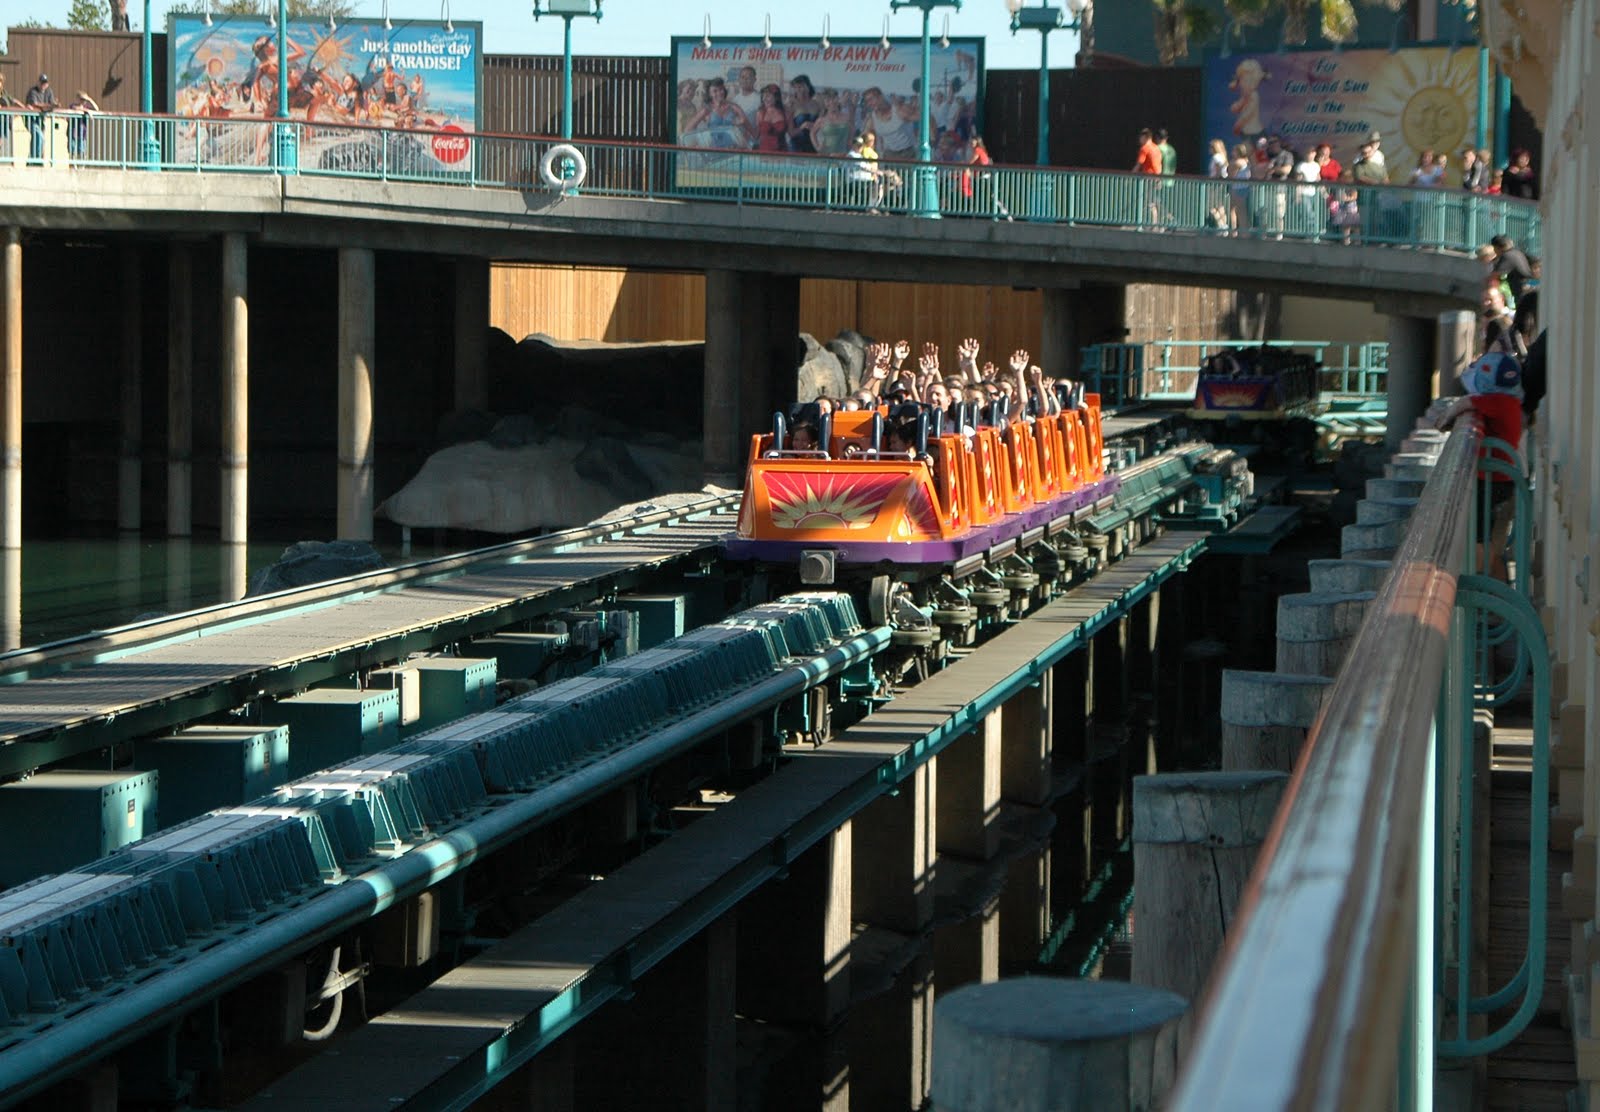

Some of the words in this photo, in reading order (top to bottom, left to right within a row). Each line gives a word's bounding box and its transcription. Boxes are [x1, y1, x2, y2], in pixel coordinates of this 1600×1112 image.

[360, 38, 390, 53] Just
[393, 40, 445, 55] another
[447, 40, 471, 59] day
[823, 46, 895, 61] BRAWNY
[374, 54, 387, 68] in
[391, 53, 461, 70] PARADISE!
[1316, 58, 1338, 73] For
[1284, 80, 1309, 94] Fun
[1312, 79, 1339, 94] and
[1343, 79, 1370, 93] Sun
[1306, 102, 1319, 113] in
[1280, 120, 1329, 134] Golden
[1334, 119, 1370, 134] State
